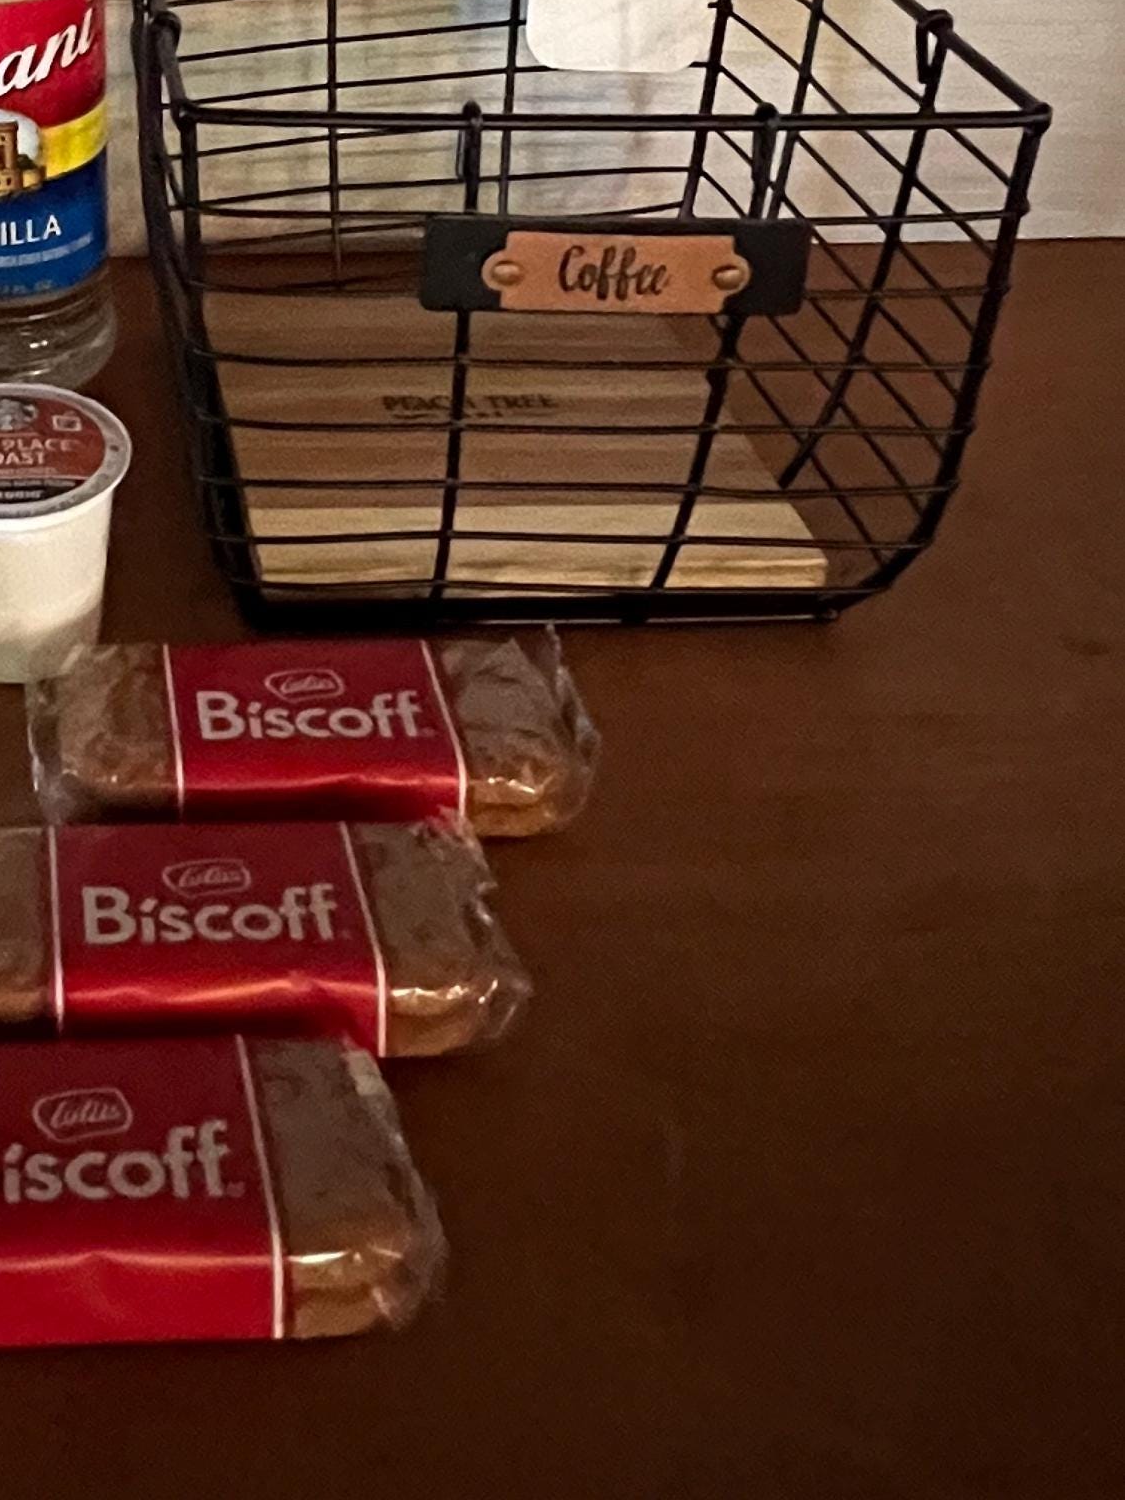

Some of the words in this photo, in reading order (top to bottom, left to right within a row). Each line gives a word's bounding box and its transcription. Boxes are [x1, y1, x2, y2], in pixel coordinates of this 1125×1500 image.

[558, 244, 671, 301] Coffee
[3, 438, 73, 452] PLACE
[196, 690, 422, 740] Biscoff
[82, 883, 337, 944] Biscoff
